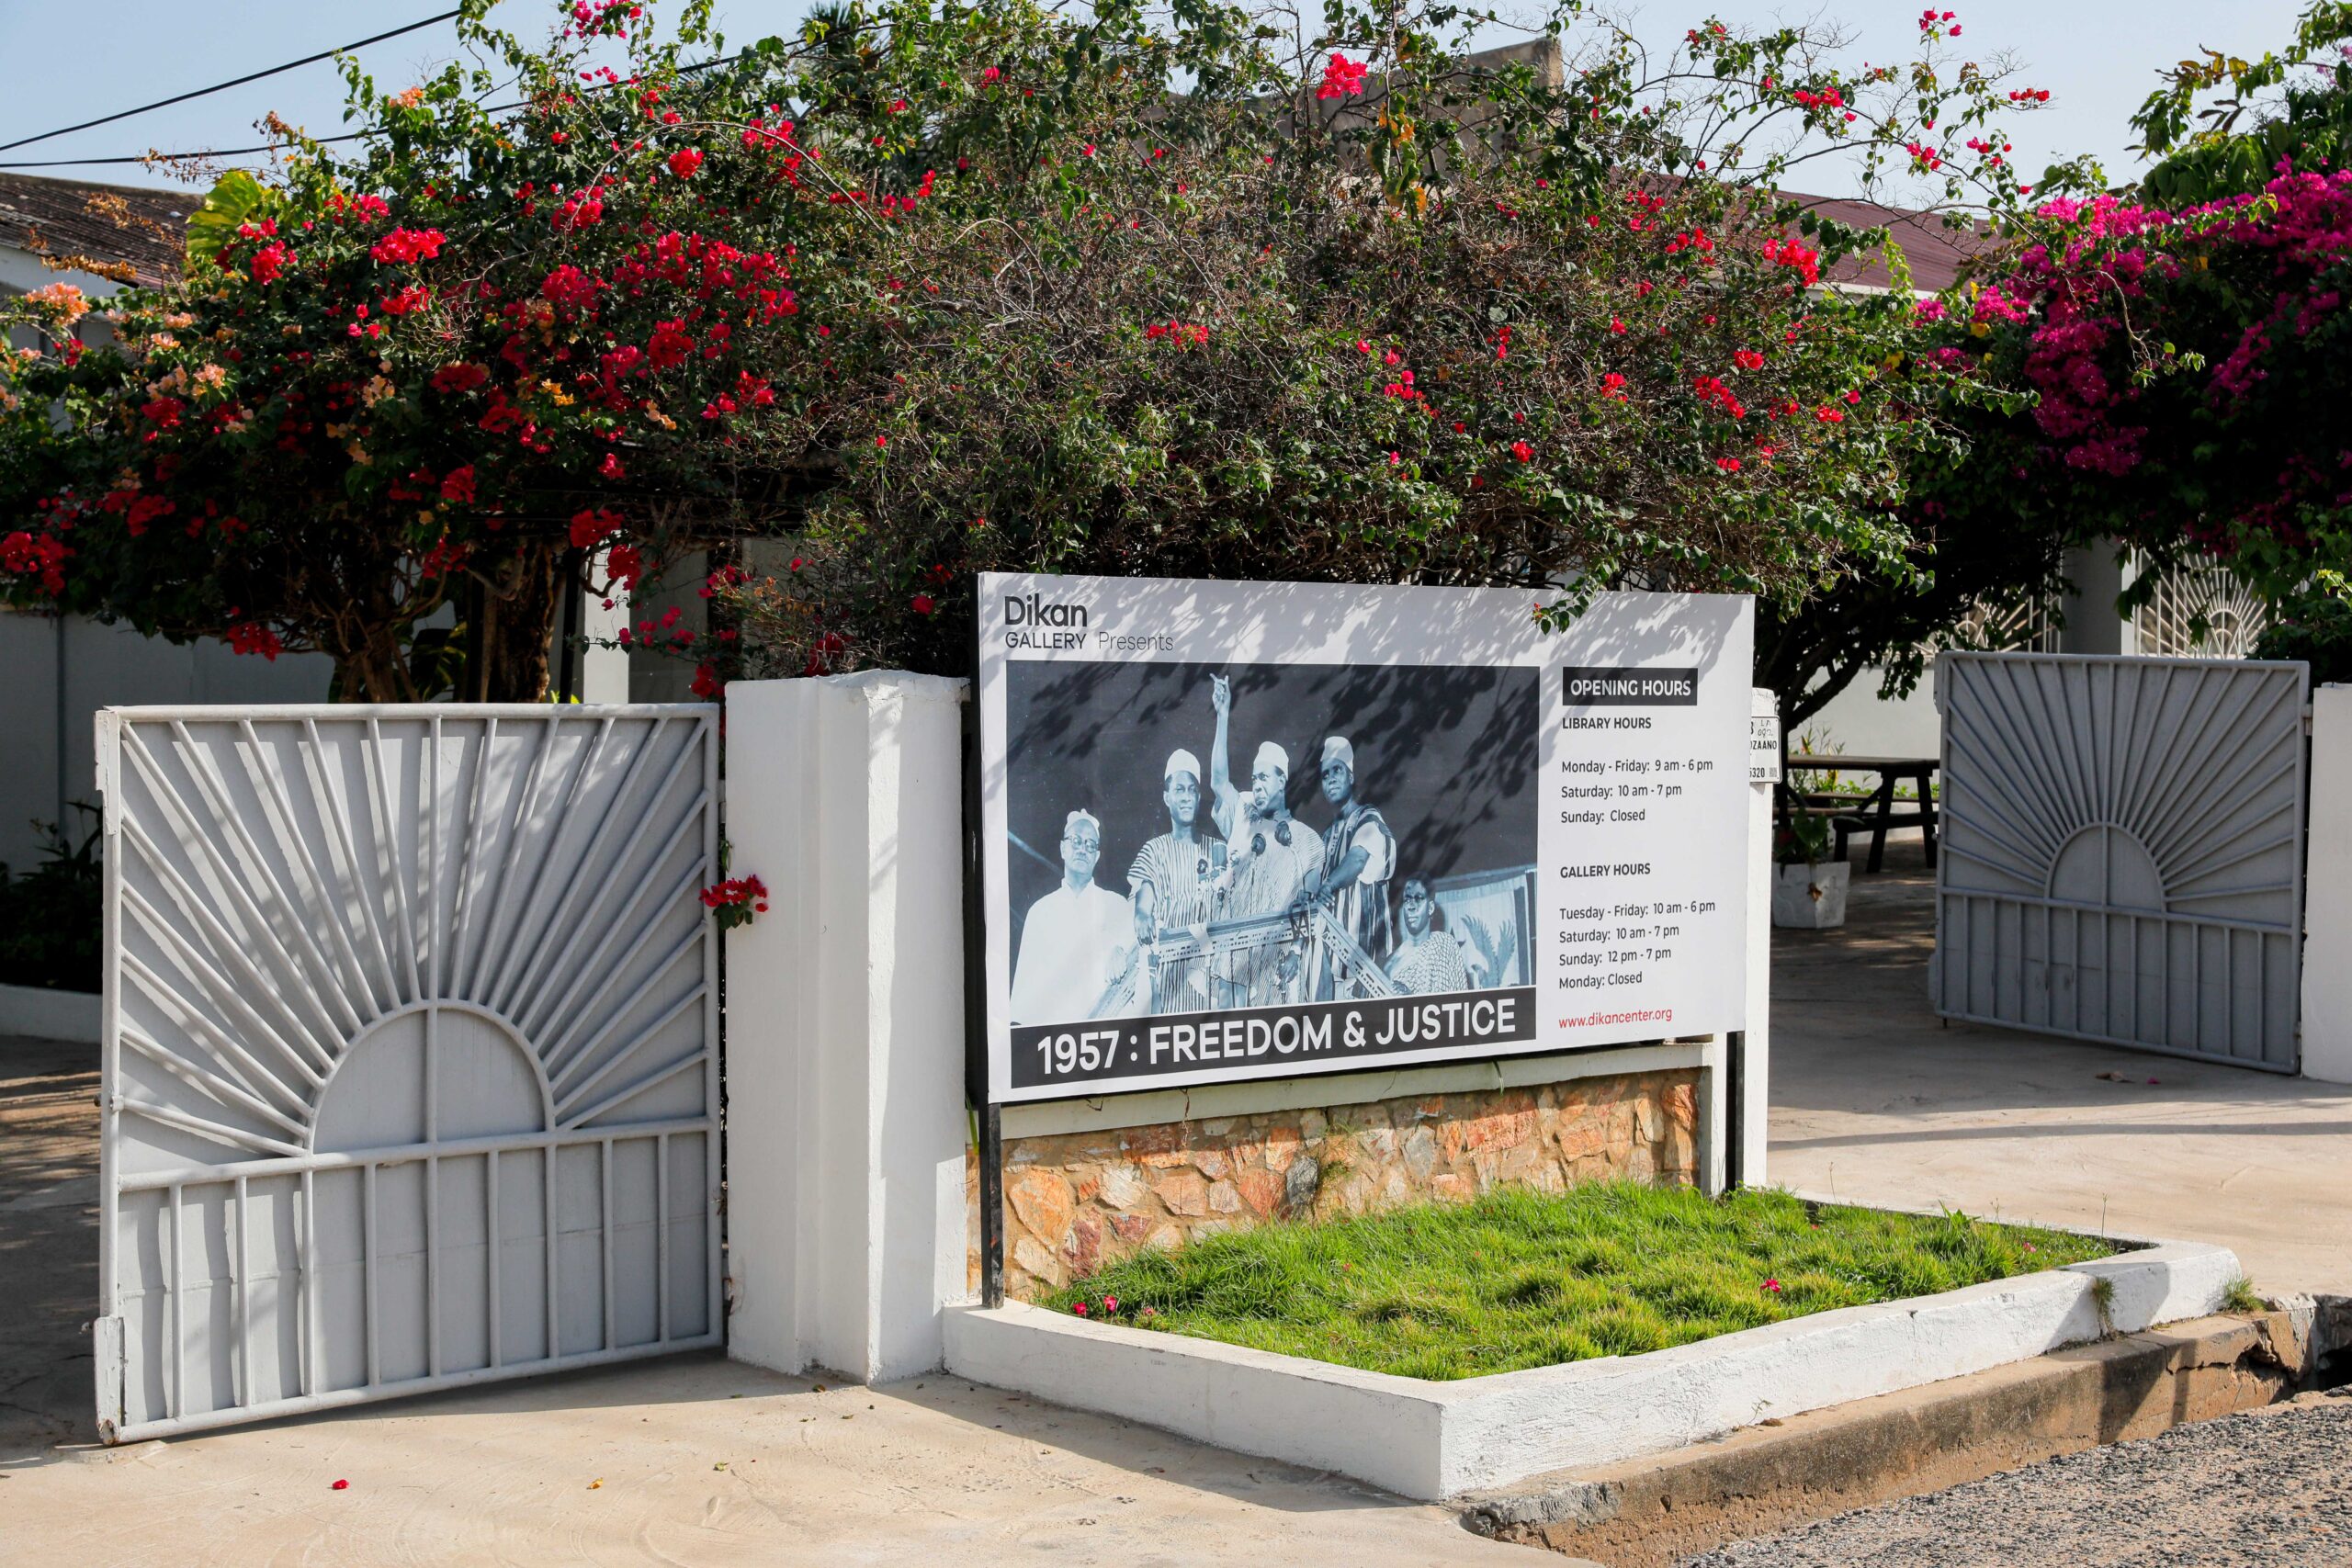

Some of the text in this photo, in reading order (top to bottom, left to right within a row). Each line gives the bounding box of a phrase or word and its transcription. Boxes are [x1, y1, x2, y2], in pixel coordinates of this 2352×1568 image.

[1005, 593, 1087, 626] Dikan
[1006, 632, 1173, 650] GALLERY Presents
[1571, 680, 1690, 695] OPENING HOURS
[1563, 717, 1651, 728] LIBRARY HOURS
[1750, 740, 1777, 750] ZAANO
[1562, 761, 1605, 775] Monday
[1616, 760, 1649, 774] Friday:
[1656, 760, 1661, 771] 9
[1664, 761, 1679, 771] am
[1689, 759, 1694, 771] 6
[1697, 761, 1713, 773] pm
[1562, 785, 1612, 800] Saturday:
[1618, 785, 1629, 796] 10
[1633, 787, 1647, 796] am
[1657, 784, 1663, 795] 7
[1666, 786, 1681, 797] pm
[1561, 808, 1645, 825] Sunday: Closed
[1560, 863, 1650, 878] GALLERY HOURS
[1560, 907, 1604, 920] Tuesday
[1615, 904, 1648, 918] Friday:
[1654, 903, 1663, 914] 10
[1667, 904, 1681, 913] am
[1690, 901, 1696, 912] 6
[1700, 902, 1715, 914] pm
[1560, 930, 1610, 943] Saturday:
[1617, 928, 1626, 939] 10
[1630, 929, 1645, 939] am
[1655, 926, 1660, 936] 7
[1664, 927, 1679, 939] pm
[1560, 953, 1601, 966] Sunday:
[1608, 951, 1617, 962] 12
[1622, 952, 1637, 964] pm
[1646, 949, 1652, 959] 7
[1656, 949, 1671, 962] pm
[1560, 971, 1642, 989] Monday: Closed
[1559, 1010, 1672, 1028] www.dikancenter.org
[1038, 1031, 1119, 1074] 1957
[1149, 1014, 1332, 1065] FREEDOM
[1343, 1011, 1366, 1047] &
[1375, 998, 1515, 1044] JUSTICE
